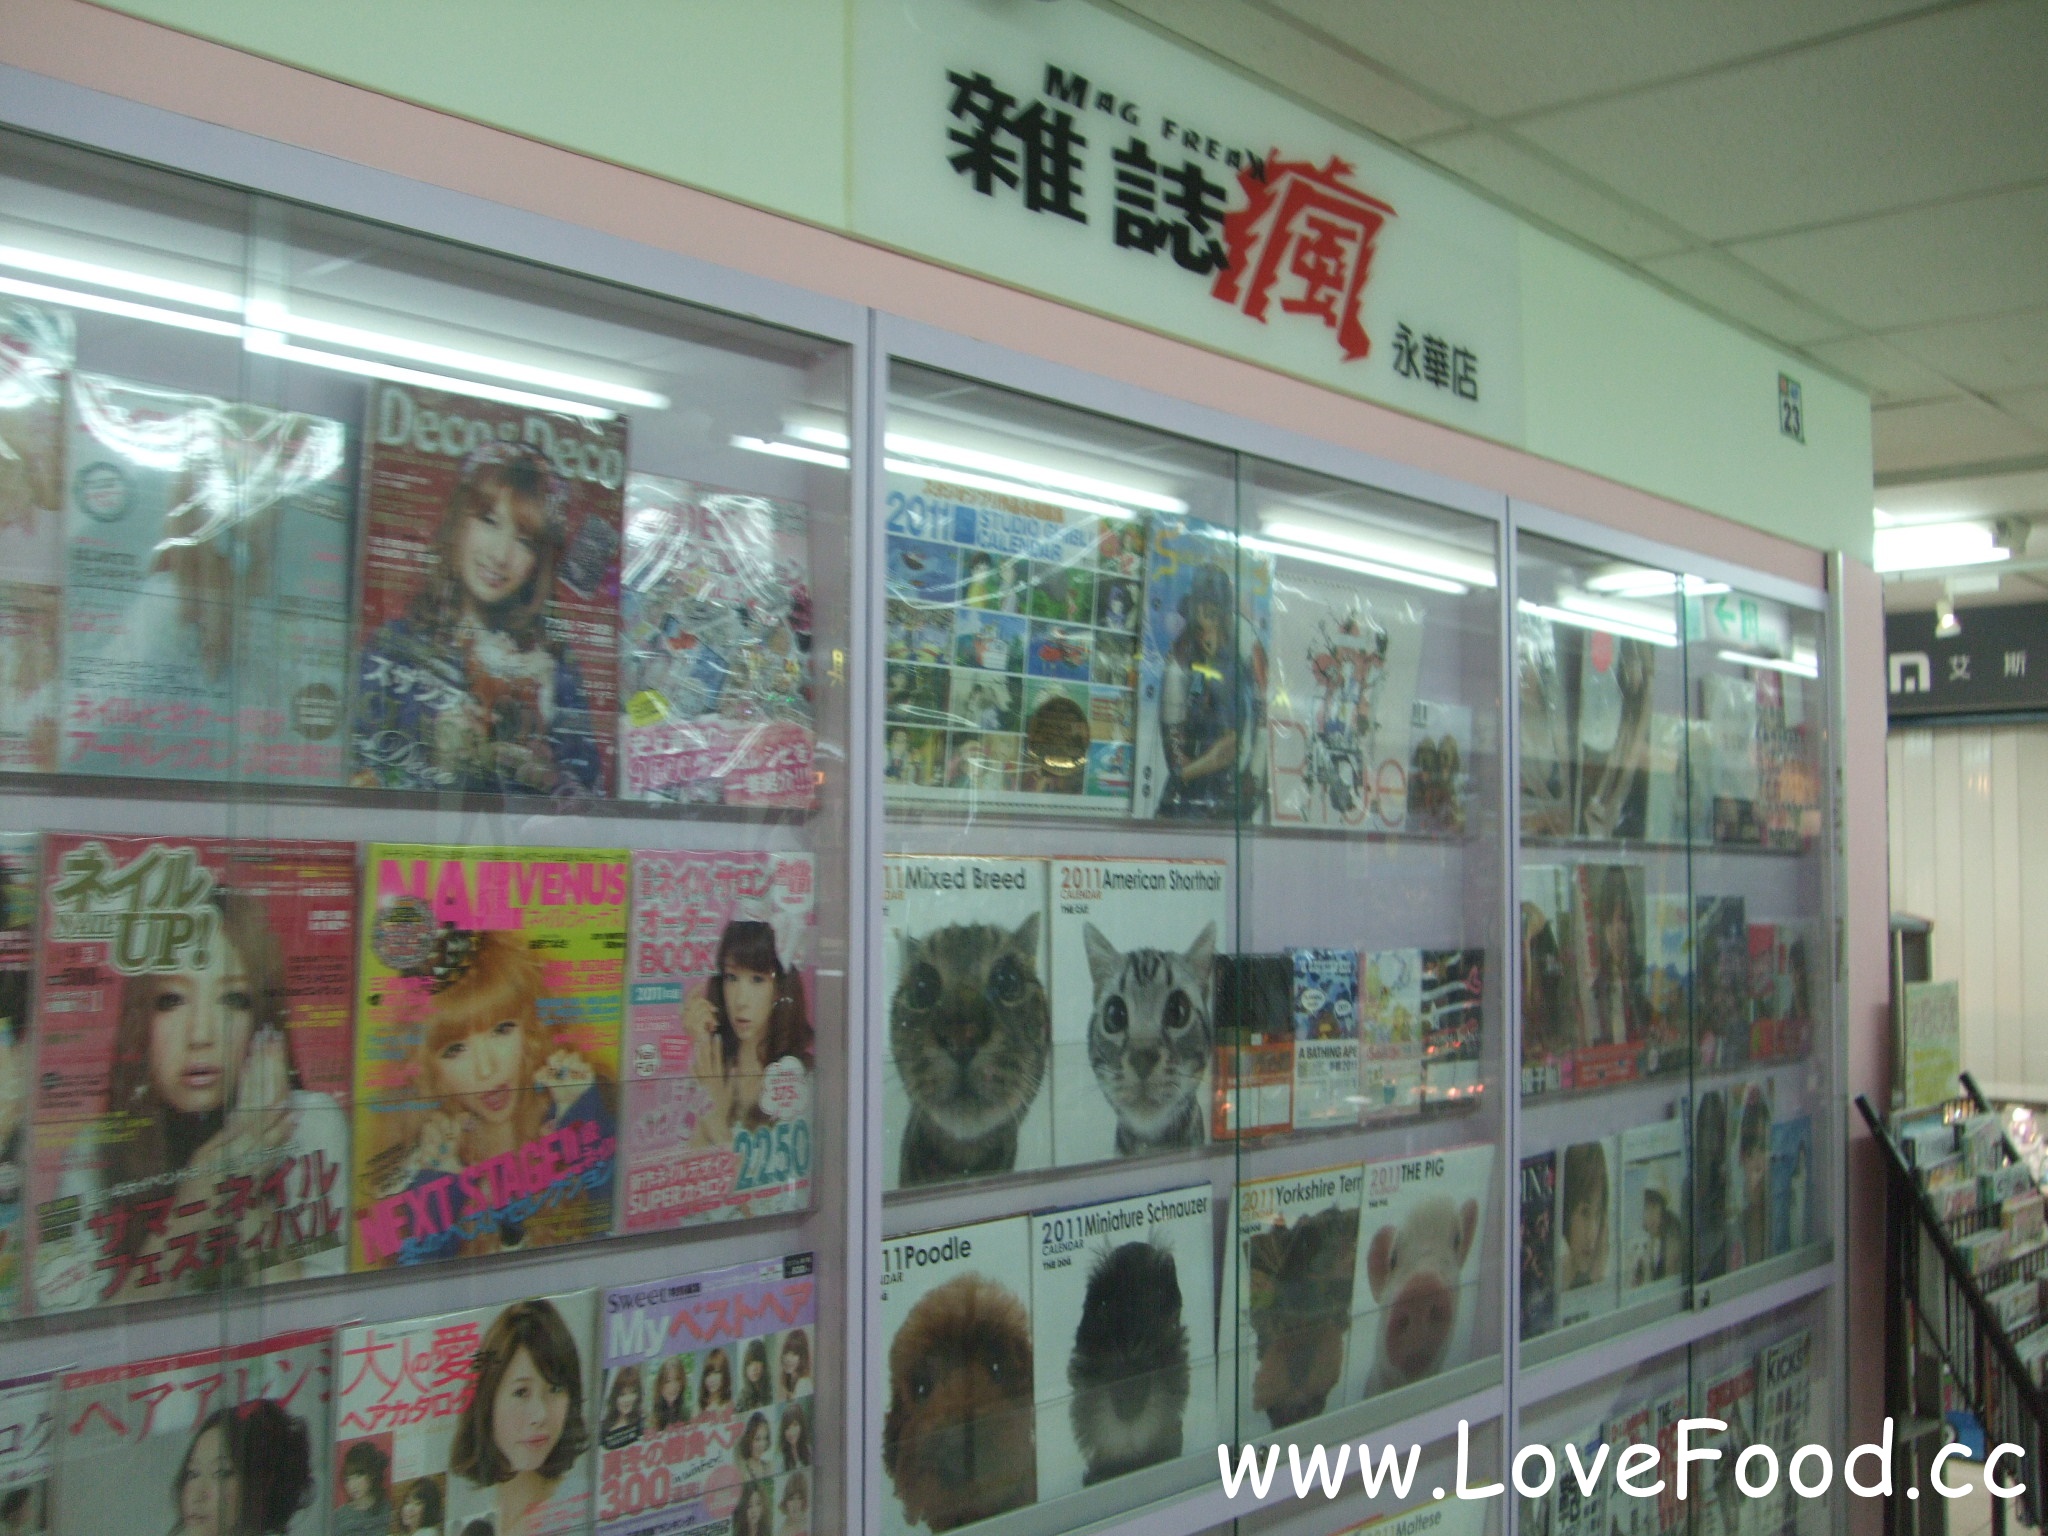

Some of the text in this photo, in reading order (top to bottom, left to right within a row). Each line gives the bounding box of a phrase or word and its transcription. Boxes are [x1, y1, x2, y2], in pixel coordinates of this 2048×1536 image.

[1045, 62, 1266, 185] MAG FREAK
[946, 68, 1397, 364] 雜誌瘋
[1392, 320, 1480, 403] 永華店
[1783, 399, 1801, 438] 23
[885, 489, 950, 541] 2011
[979, 509, 1040, 536] STUDIO
[53, 848, 209, 913] ネイル
[511, 861, 627, 906] VENUS
[905, 865, 966, 890] Mixed
[973, 865, 1027, 890] Breed
[1061, 865, 1222, 892] 2011 American Shorthair
[116, 908, 216, 971] UP!
[639, 941, 719, 974] BOOK
[734, 1119, 810, 1191] 2250
[1401, 1162, 1422, 1184] THE
[1424, 1157, 1445, 1180] PIG
[88, 1149, 341, 1253] サマーネイル
[1276, 1178, 1336, 1206] Yorkshire
[357, 1173, 456, 1265] NEXT
[1042, 1217, 1083, 1246] 2011
[1084, 1207, 1144, 1237] Miniature
[1146, 1196, 1208, 1225] Schnauzer
[94, 1196, 342, 1298] フェスティバル
[904, 1235, 972, 1270] Poodle
[1042, 1238, 1085, 1257] CALENDAR
[609, 1309, 671, 1360] My
[668, 1281, 814, 1344] ベストヘア
[69, 1347, 331, 1444] ヘアアレン
